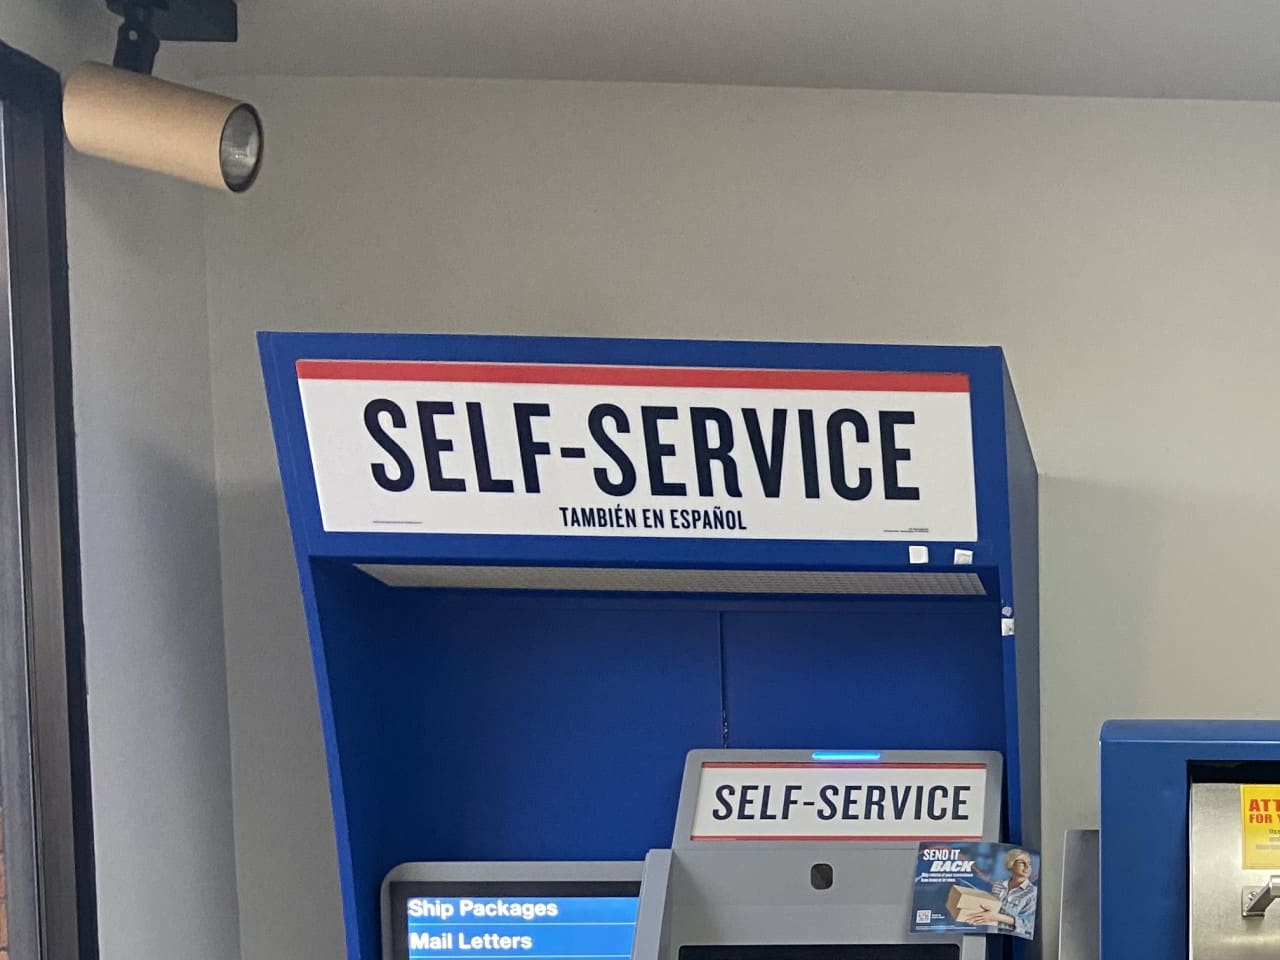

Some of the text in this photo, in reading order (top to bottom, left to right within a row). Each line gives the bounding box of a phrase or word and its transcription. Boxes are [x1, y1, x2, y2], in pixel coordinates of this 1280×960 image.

[363, 398, 921, 501] SELF-SERVICE
[558, 504, 747, 530] TAMBIÉN EN ESPAÑOL
[712, 785, 971, 821] SELF-SERVICE
[1249, 814, 1273, 824] FOR
[923, 849, 960, 860] SEND IT
[930, 860, 975, 872] BACK
[407, 899, 558, 920] Ship Packages
[409, 932, 532, 950] Mail Letters
